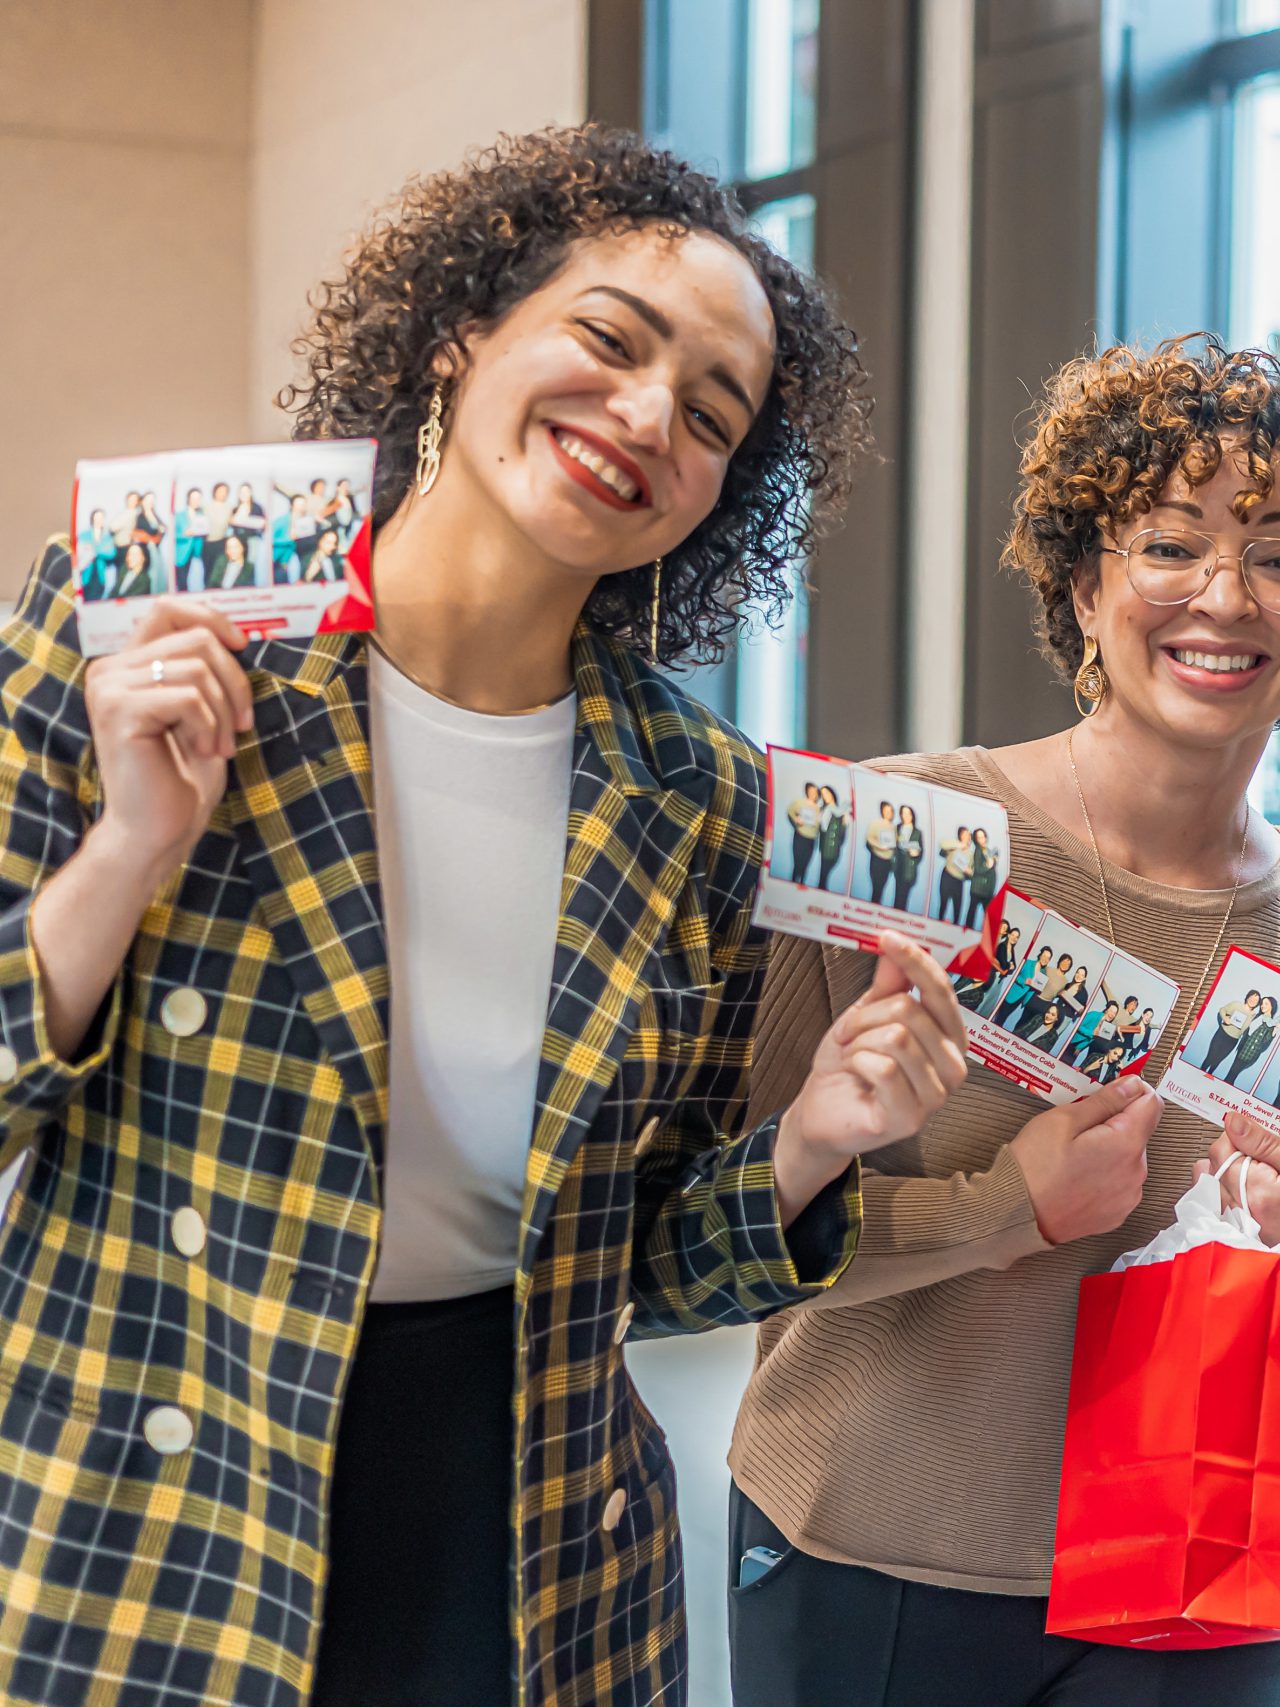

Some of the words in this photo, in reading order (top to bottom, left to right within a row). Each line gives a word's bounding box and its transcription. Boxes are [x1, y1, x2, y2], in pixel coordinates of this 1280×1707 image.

[978, 1034, 1005, 1052] Women's
[1005, 1049, 1049, 1077] Empowerment
[1049, 1074, 1078, 1093] Initiatives
[982, 1024, 991, 1032] Dr.
[991, 1029, 1010, 1043] Jewel
[1012, 1041, 1039, 1059] Plummer
[1039, 1056, 1056, 1069] Cobb
[1167, 1081, 1201, 1104] RUTGERS
[1209, 1092, 1240, 1111] S.T.E.A.M.
[1240, 1108, 1270, 1126] Women's
[1244, 1099, 1253, 1107] Dr.
[1254, 1104, 1273, 1117] Jewel
